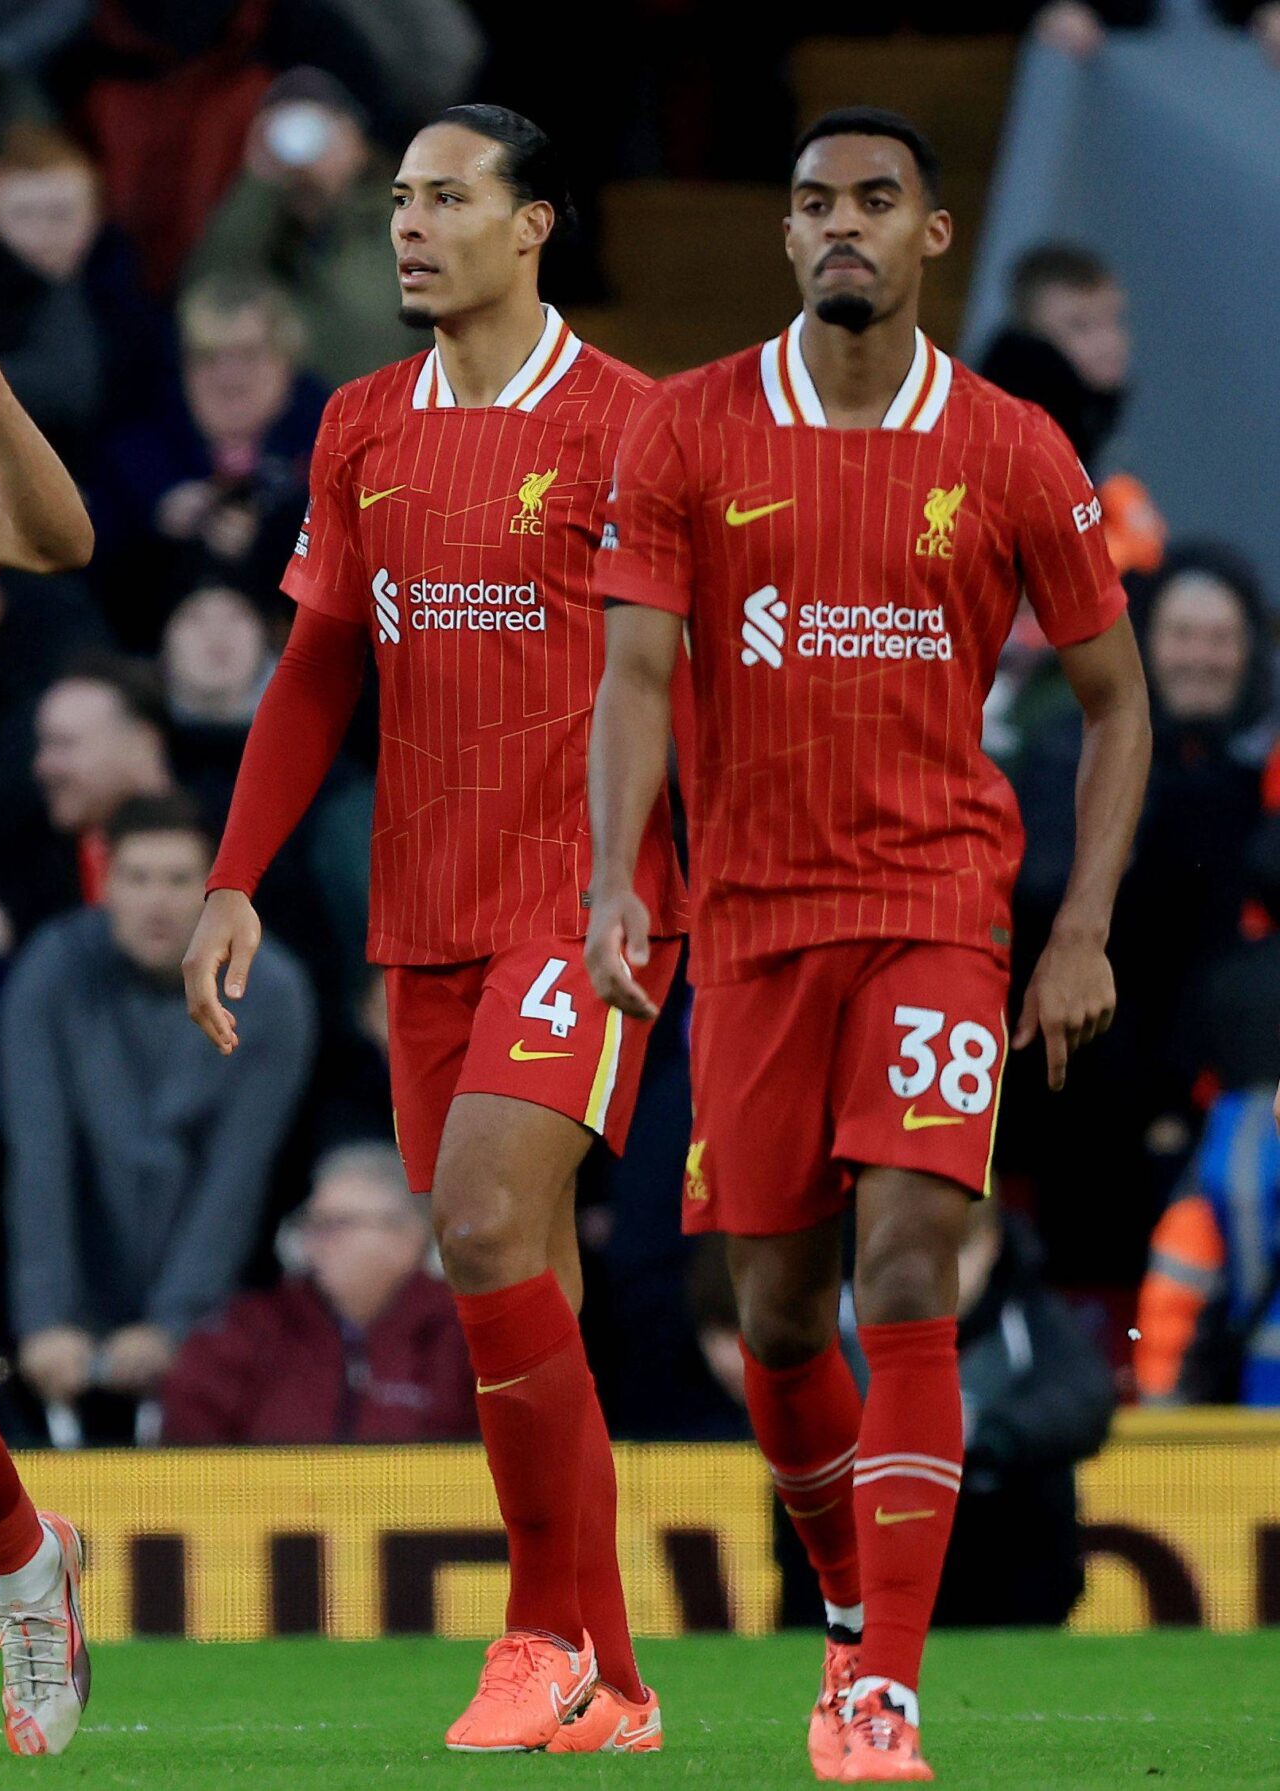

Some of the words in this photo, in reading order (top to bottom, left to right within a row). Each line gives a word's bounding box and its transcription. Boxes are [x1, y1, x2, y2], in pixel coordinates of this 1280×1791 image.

[410, 578, 535, 605] standard
[411, 604, 545, 631] chartered
[798, 599, 944, 633] standard
[797, 628, 953, 662] chartered
[520, 957, 578, 1039] 4
[887, 1004, 998, 1115] 38
